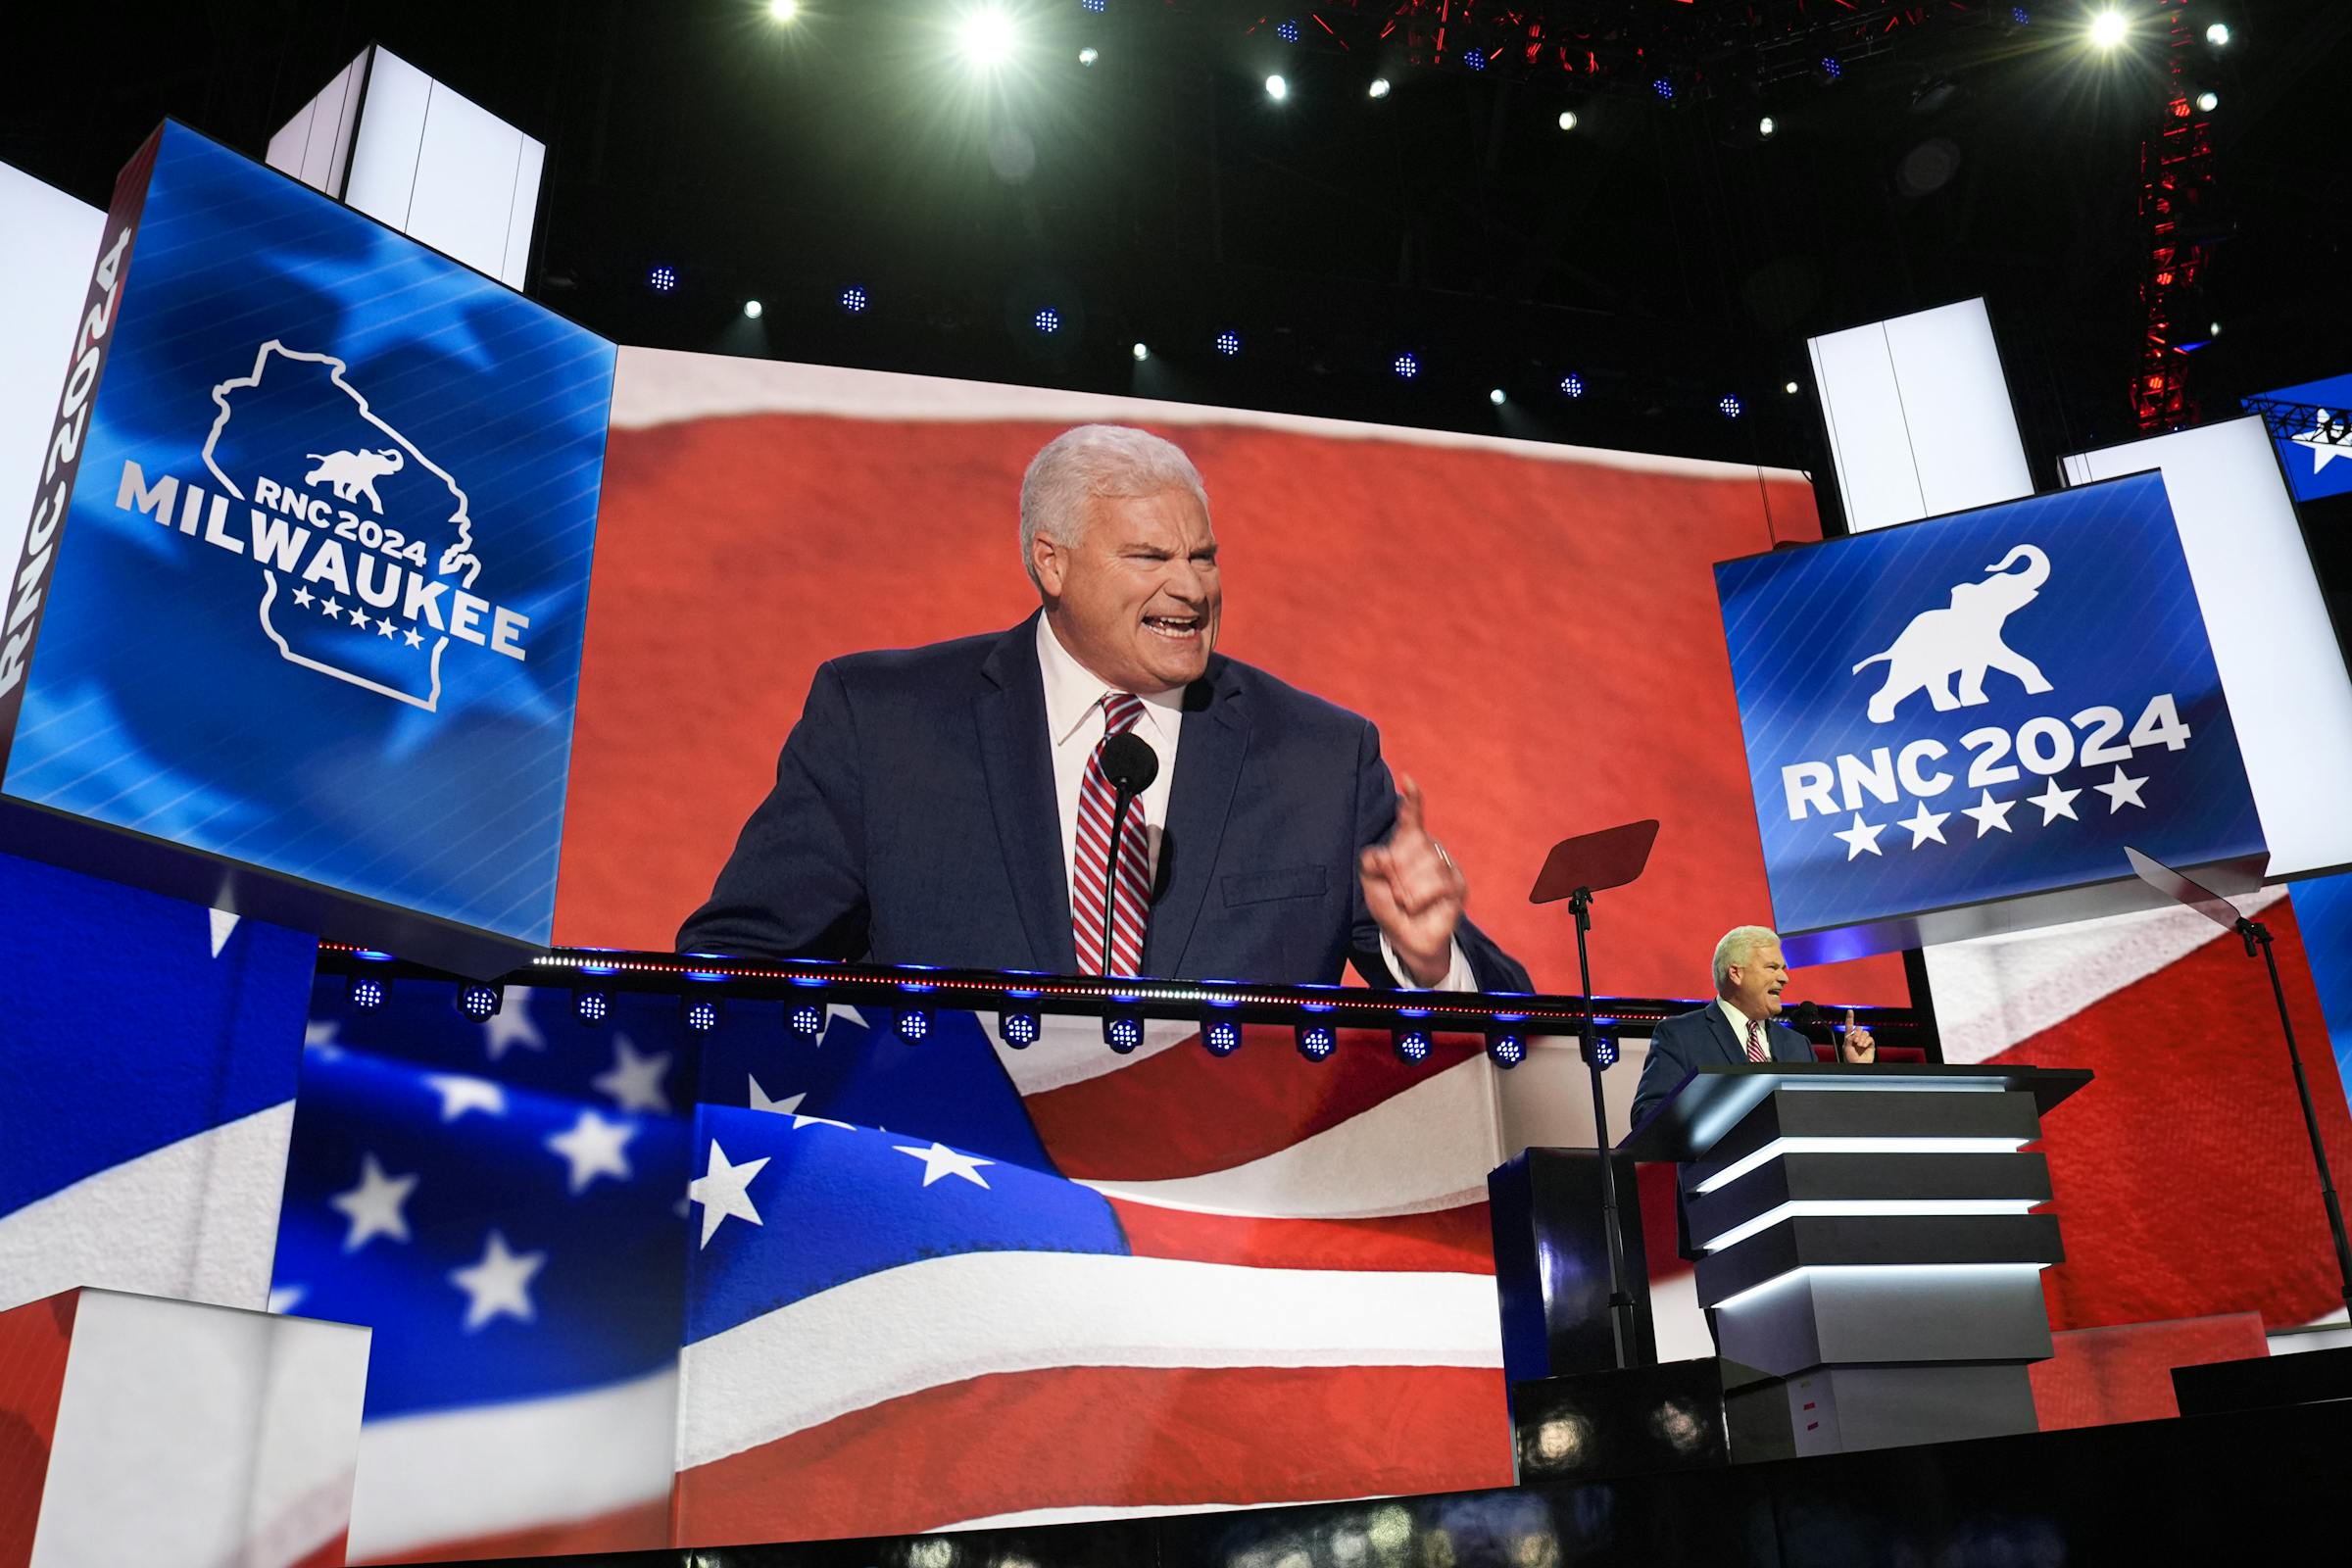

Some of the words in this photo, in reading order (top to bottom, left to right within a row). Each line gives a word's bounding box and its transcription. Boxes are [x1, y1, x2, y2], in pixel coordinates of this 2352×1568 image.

[0, 480, 66, 699] RNC
[46, 226, 131, 485] 2024
[255, 476, 332, 529] RNC
[334, 511, 427, 567] 2024
[116, 460, 529, 662] MILWAUKEE
[1781, 739, 1954, 821] RNC
[1960, 693, 2191, 788] 2024
